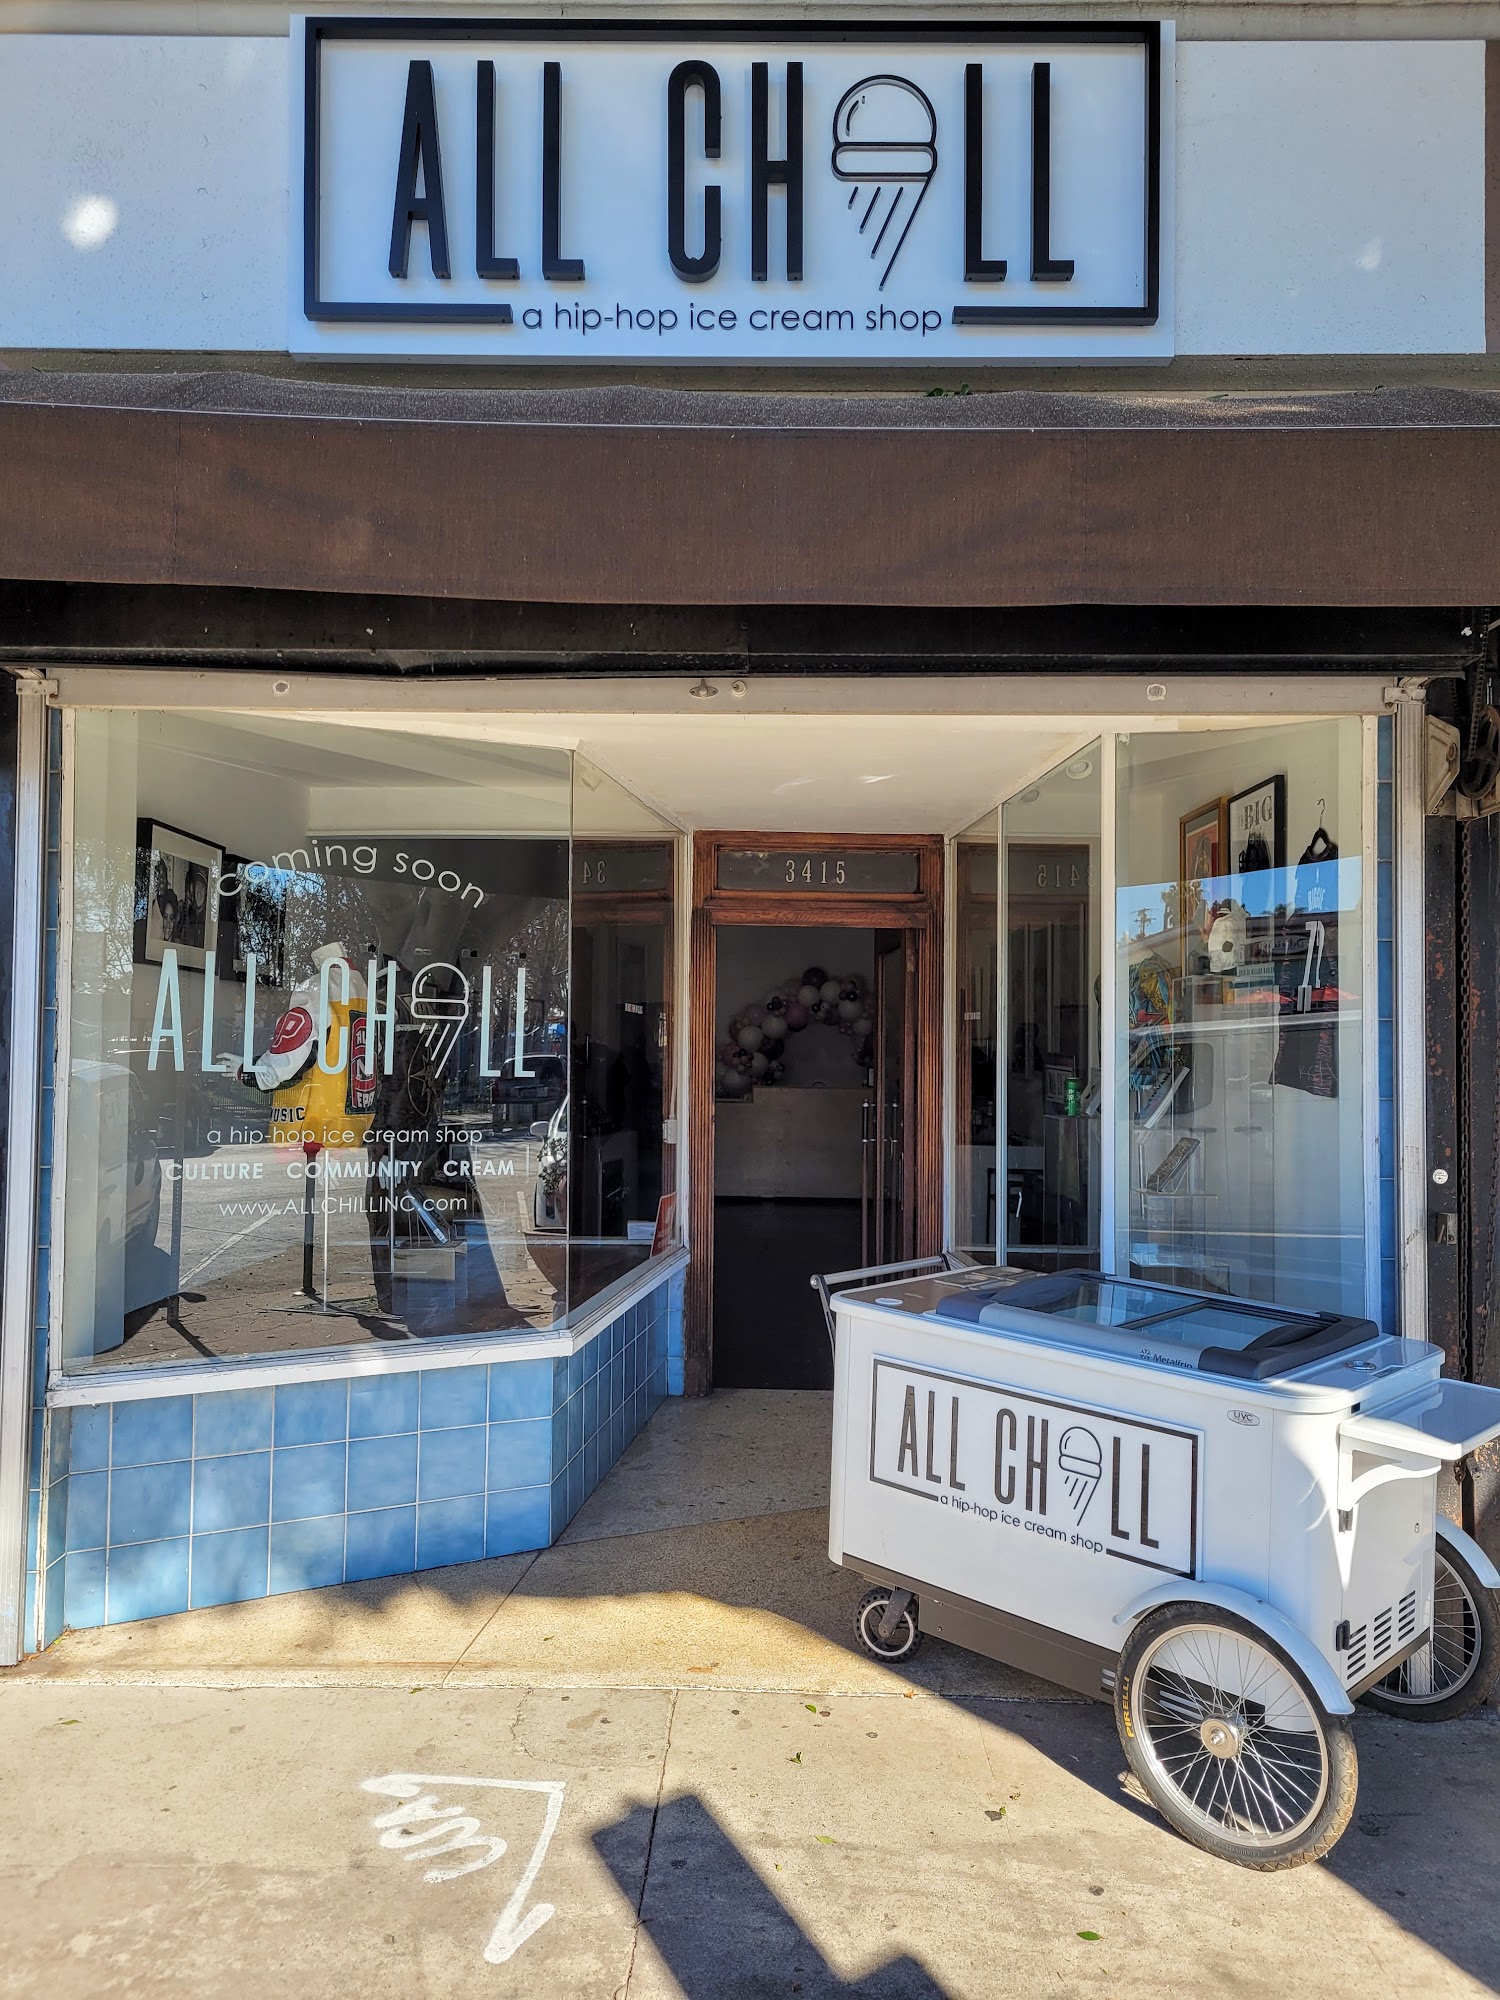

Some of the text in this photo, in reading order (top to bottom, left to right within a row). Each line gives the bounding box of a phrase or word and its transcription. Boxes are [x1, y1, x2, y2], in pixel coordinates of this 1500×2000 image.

[388, 60, 586, 281] ALL
[522, 302, 942, 337] a hip-hop ice cream shop
[1244, 796, 1272, 830] BIG
[216, 839, 485, 909] coming soon
[785, 860, 846, 884] 3415
[147, 948, 267, 1072] ALL
[206, 1125, 483, 1148] a hip-hop ice cream shop
[165, 1159, 515, 1181] CULTURE COMMUNITY CREAM
[218, 1195, 468, 1217] www.ALLCHILLINC.com
[1153, 1353, 1193, 1369] Metalfrio
[1233, 1411, 1253, 1421] UVC
[897, 1384, 966, 1492] ALL
[940, 1495, 1103, 1554] a hip-hop ice cream shop
[1122, 1675, 1135, 1738] PIRELLI
